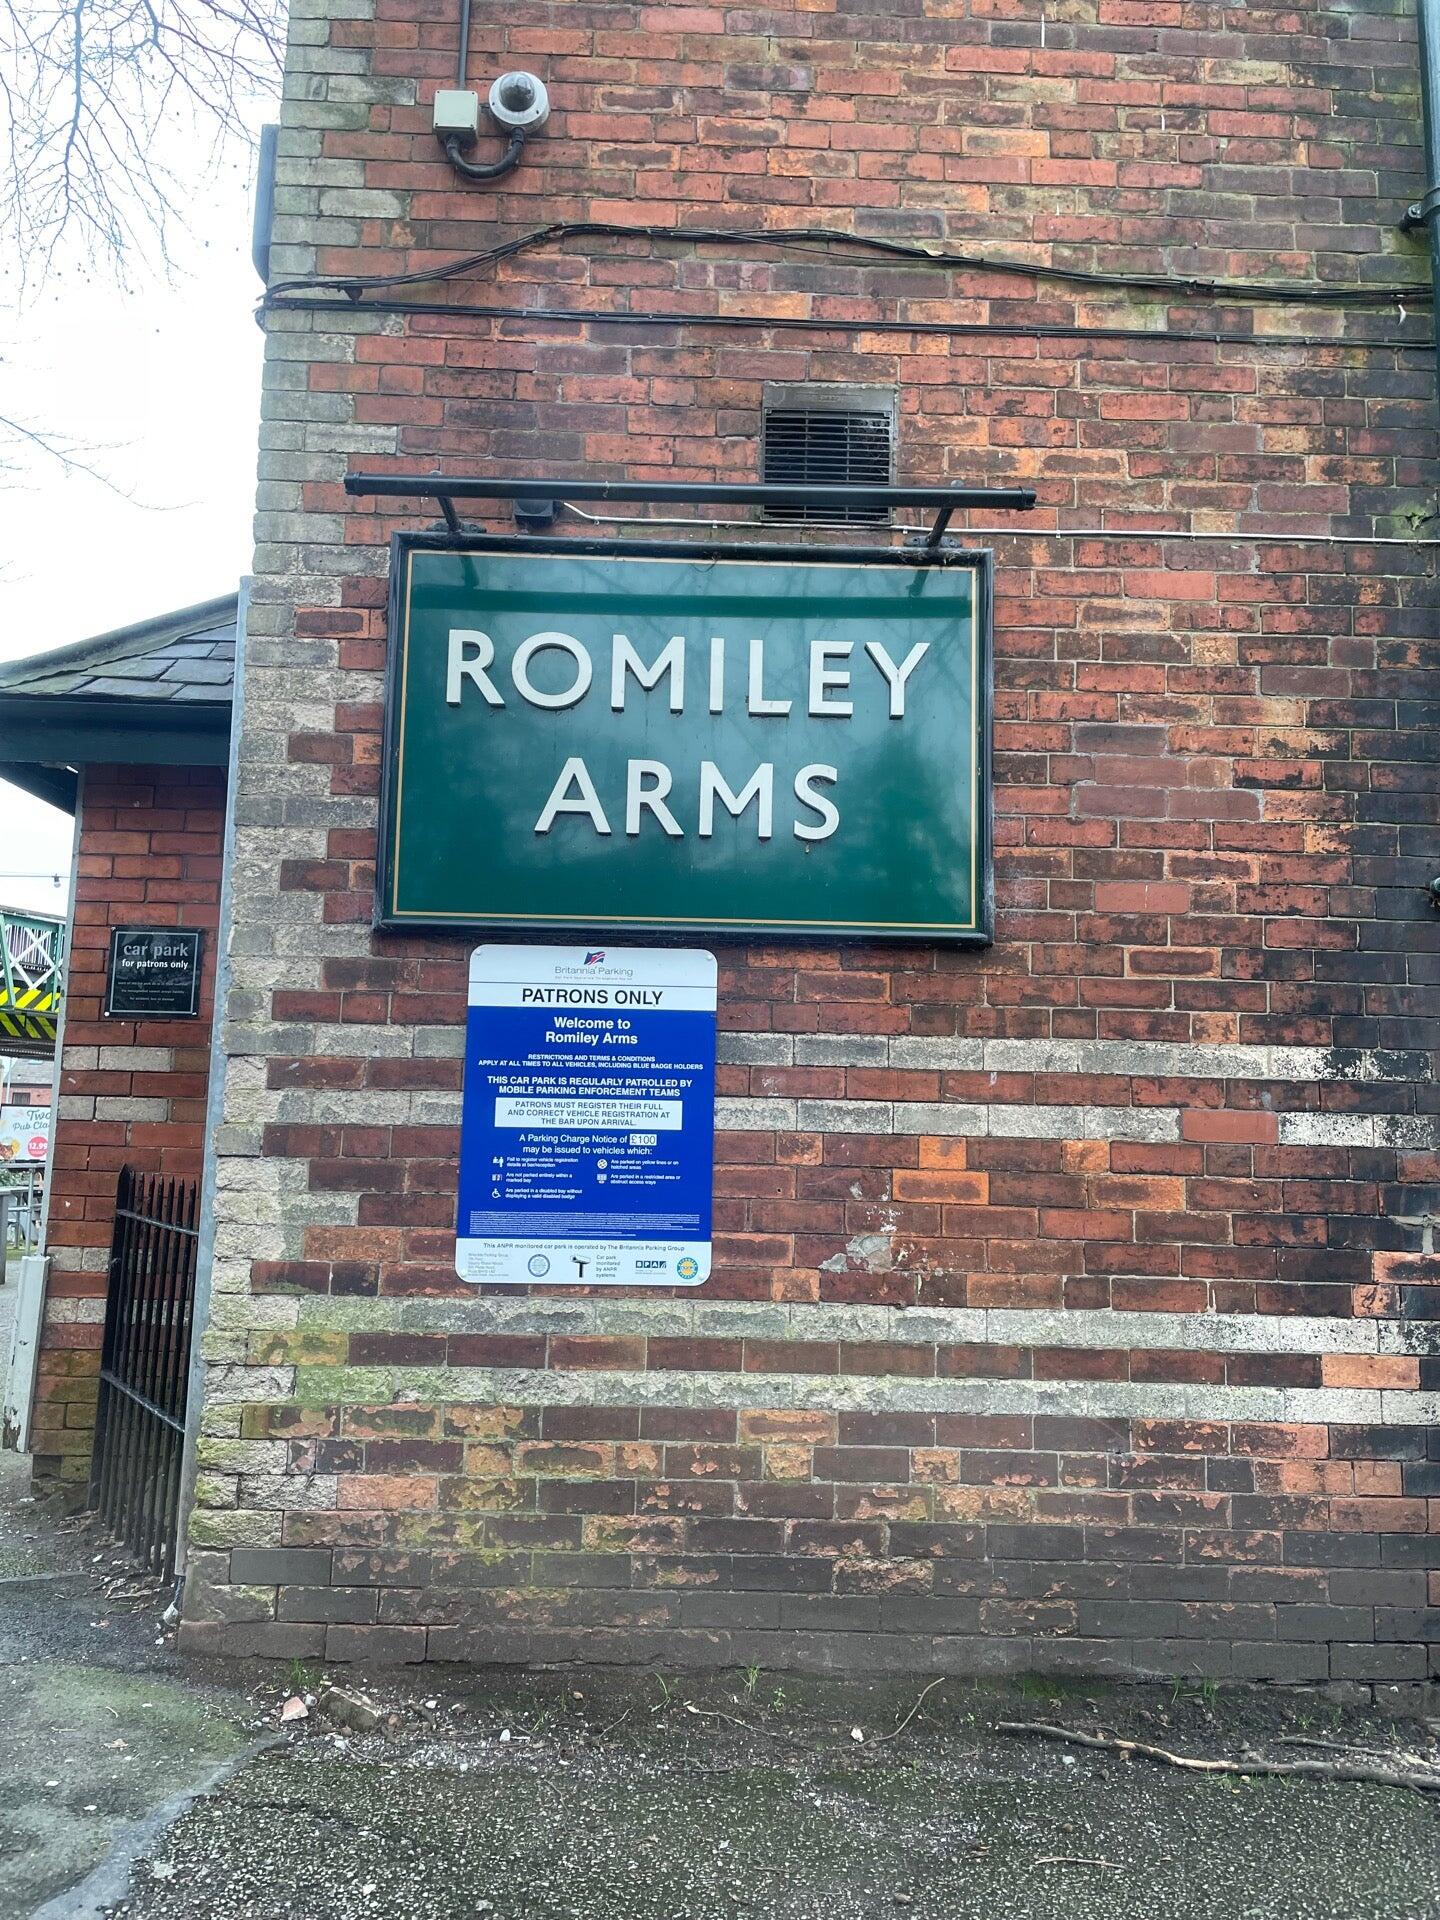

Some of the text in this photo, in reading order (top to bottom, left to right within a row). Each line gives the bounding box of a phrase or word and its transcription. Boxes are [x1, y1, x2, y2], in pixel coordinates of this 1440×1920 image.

[446, 629, 930, 719] ROMILEY
[534, 757, 840, 841] ARMS
[124, 943, 188, 959] car park
[122, 959, 188, 970] for patrons only
[555, 966, 633, 977] Britannia Parking
[522, 988, 663, 1005] PATRONS ONLY
[554, 1016, 630, 1029] Welcome to
[545, 1032, 638, 1046] Romiley Arms
[487, 1076, 507, 1084] THIS
[510, 1076, 529, 1084] CAR
[536, 1086, 576, 1094] PARKING
[579, 1087, 647, 1095] ENFORCEMENT
[649, 1088, 680, 1096] TEAMS
[528, 1134, 558, 1144] Parking
[561, 1135, 590, 1144] Charge
[592, 1135, 617, 1143] Notice
[631, 1135, 656, 1144] £100
